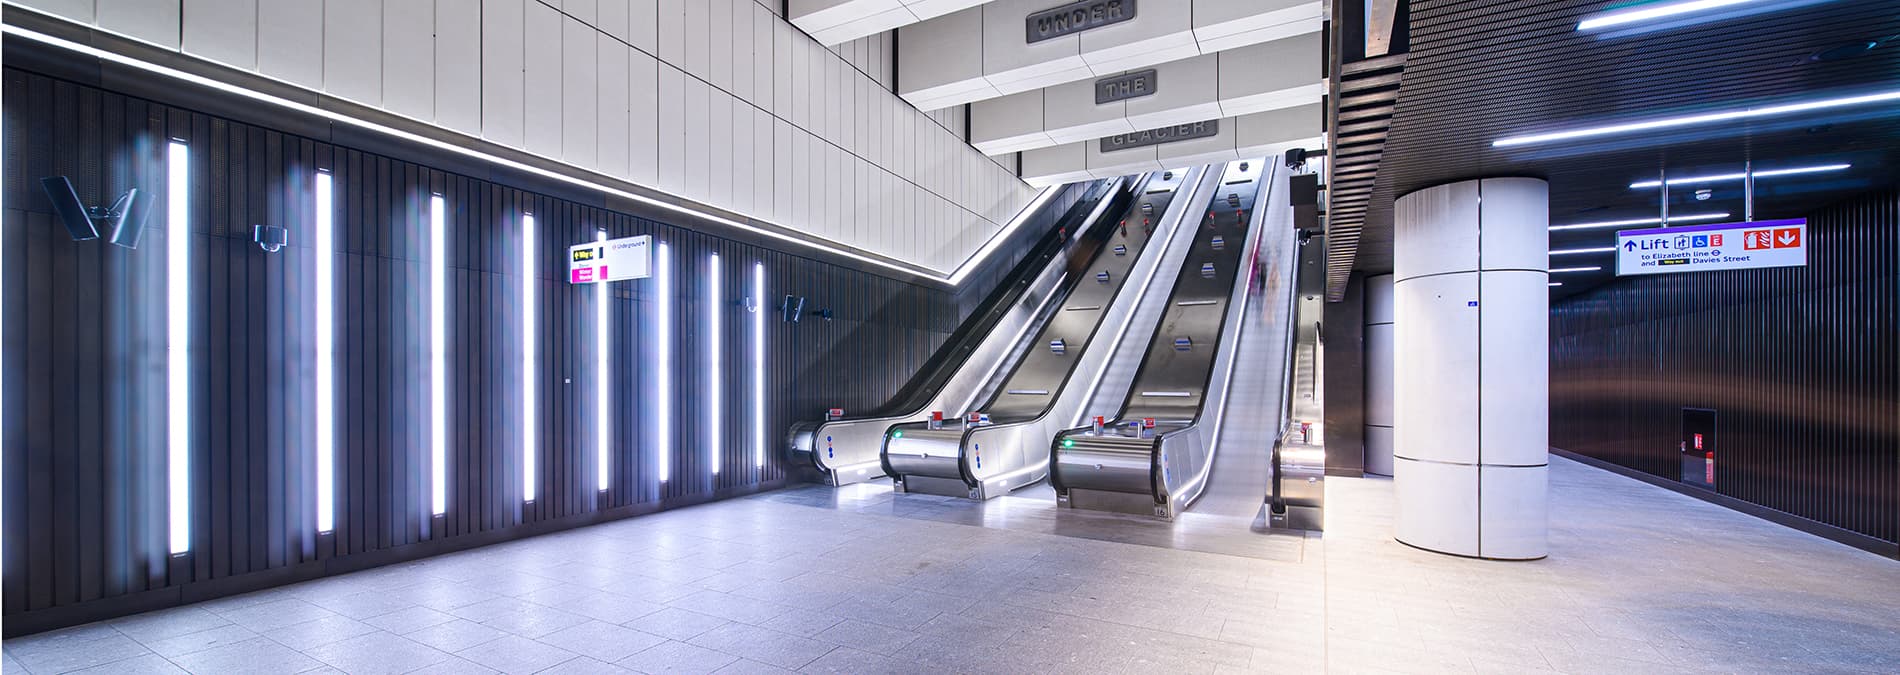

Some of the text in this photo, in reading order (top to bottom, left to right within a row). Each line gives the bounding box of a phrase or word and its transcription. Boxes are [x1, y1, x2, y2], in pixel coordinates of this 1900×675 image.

[1038, 1, 1123, 36] UNDER
[1105, 77, 1146, 98] THE
[1111, 121, 1206, 145] GLACIER
[617, 241, 641, 249] Underground
[1641, 238, 1669, 250] Lift
[1652, 251, 1691, 259] Elizabeth
[1156, 507, 1165, 516] 16
